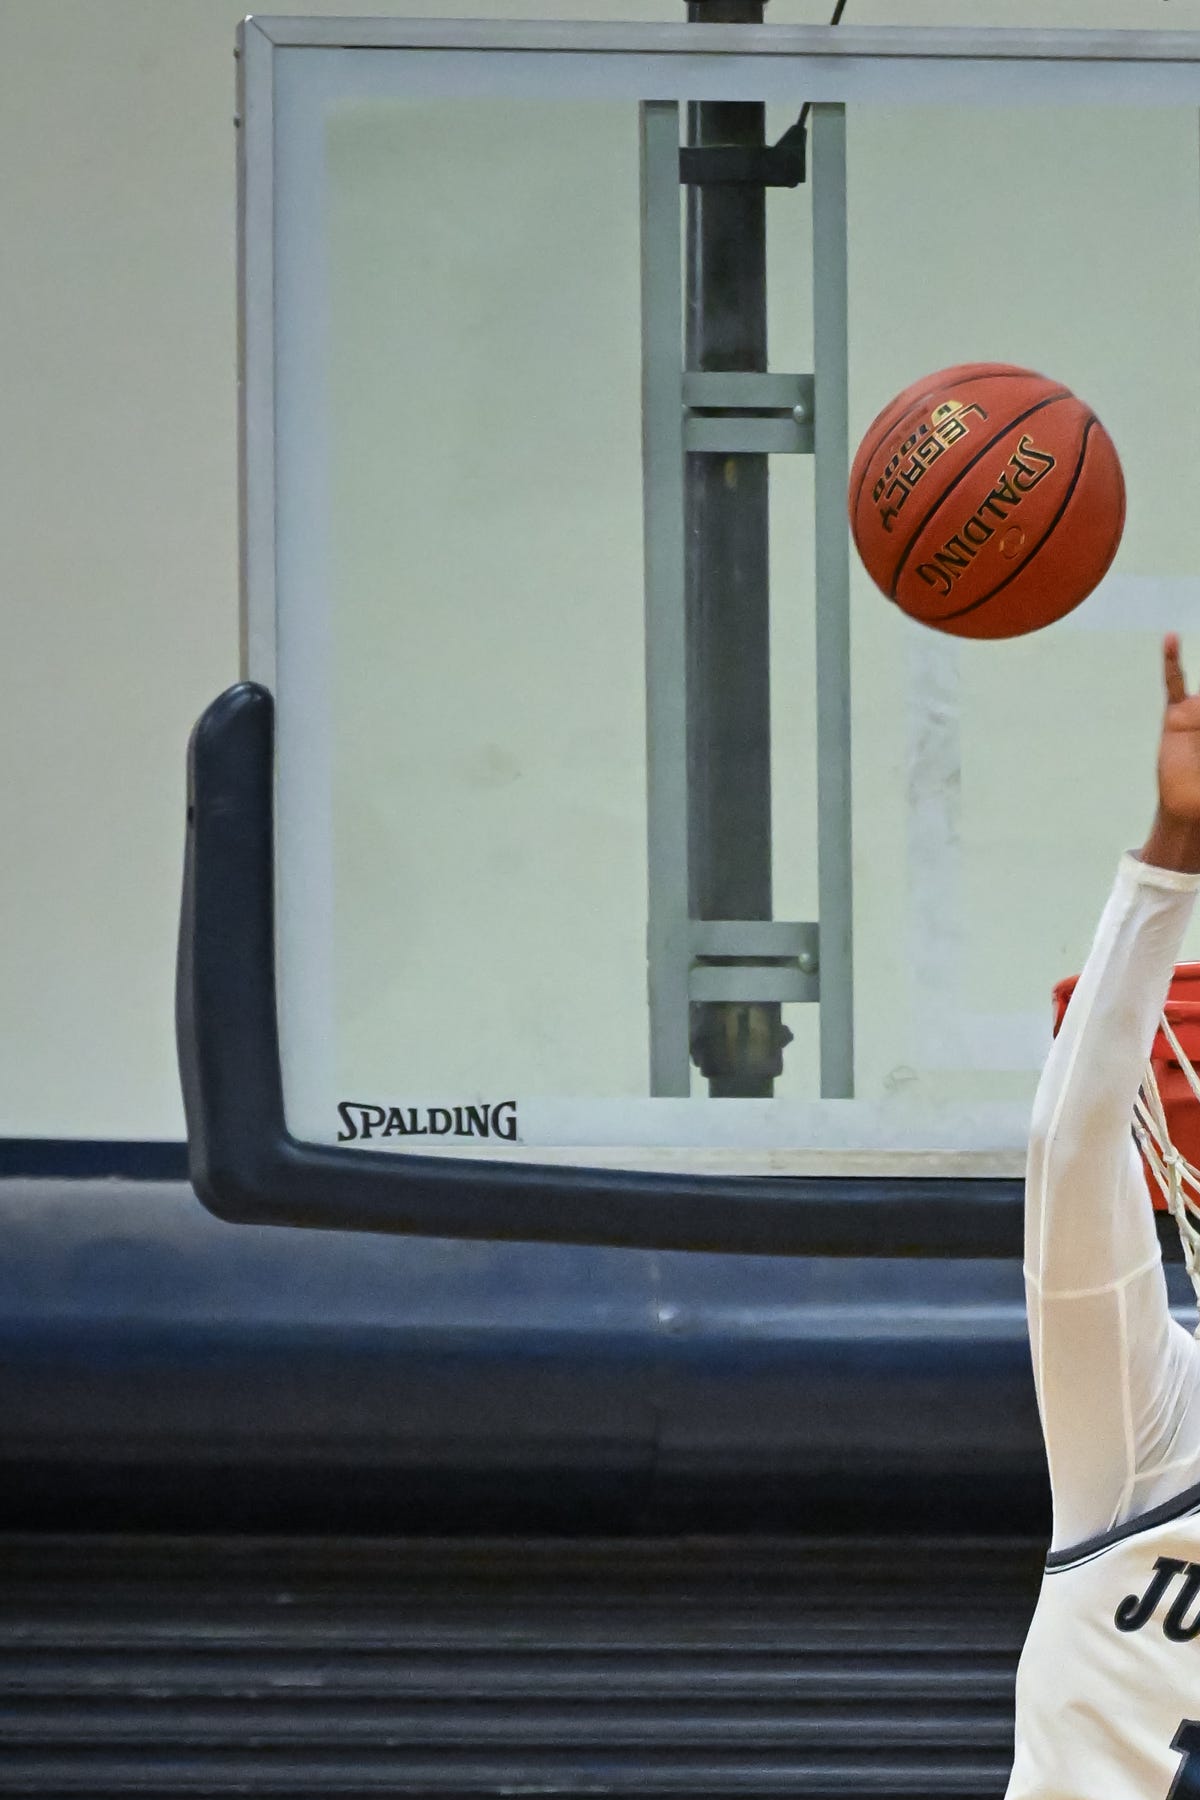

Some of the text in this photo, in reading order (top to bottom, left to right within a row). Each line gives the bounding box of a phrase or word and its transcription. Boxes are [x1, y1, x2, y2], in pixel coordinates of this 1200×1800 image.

[878, 402, 989, 533] LEGACY
[915, 434, 1056, 597] SPALDING
[337, 1100, 517, 1142] SPALDING
